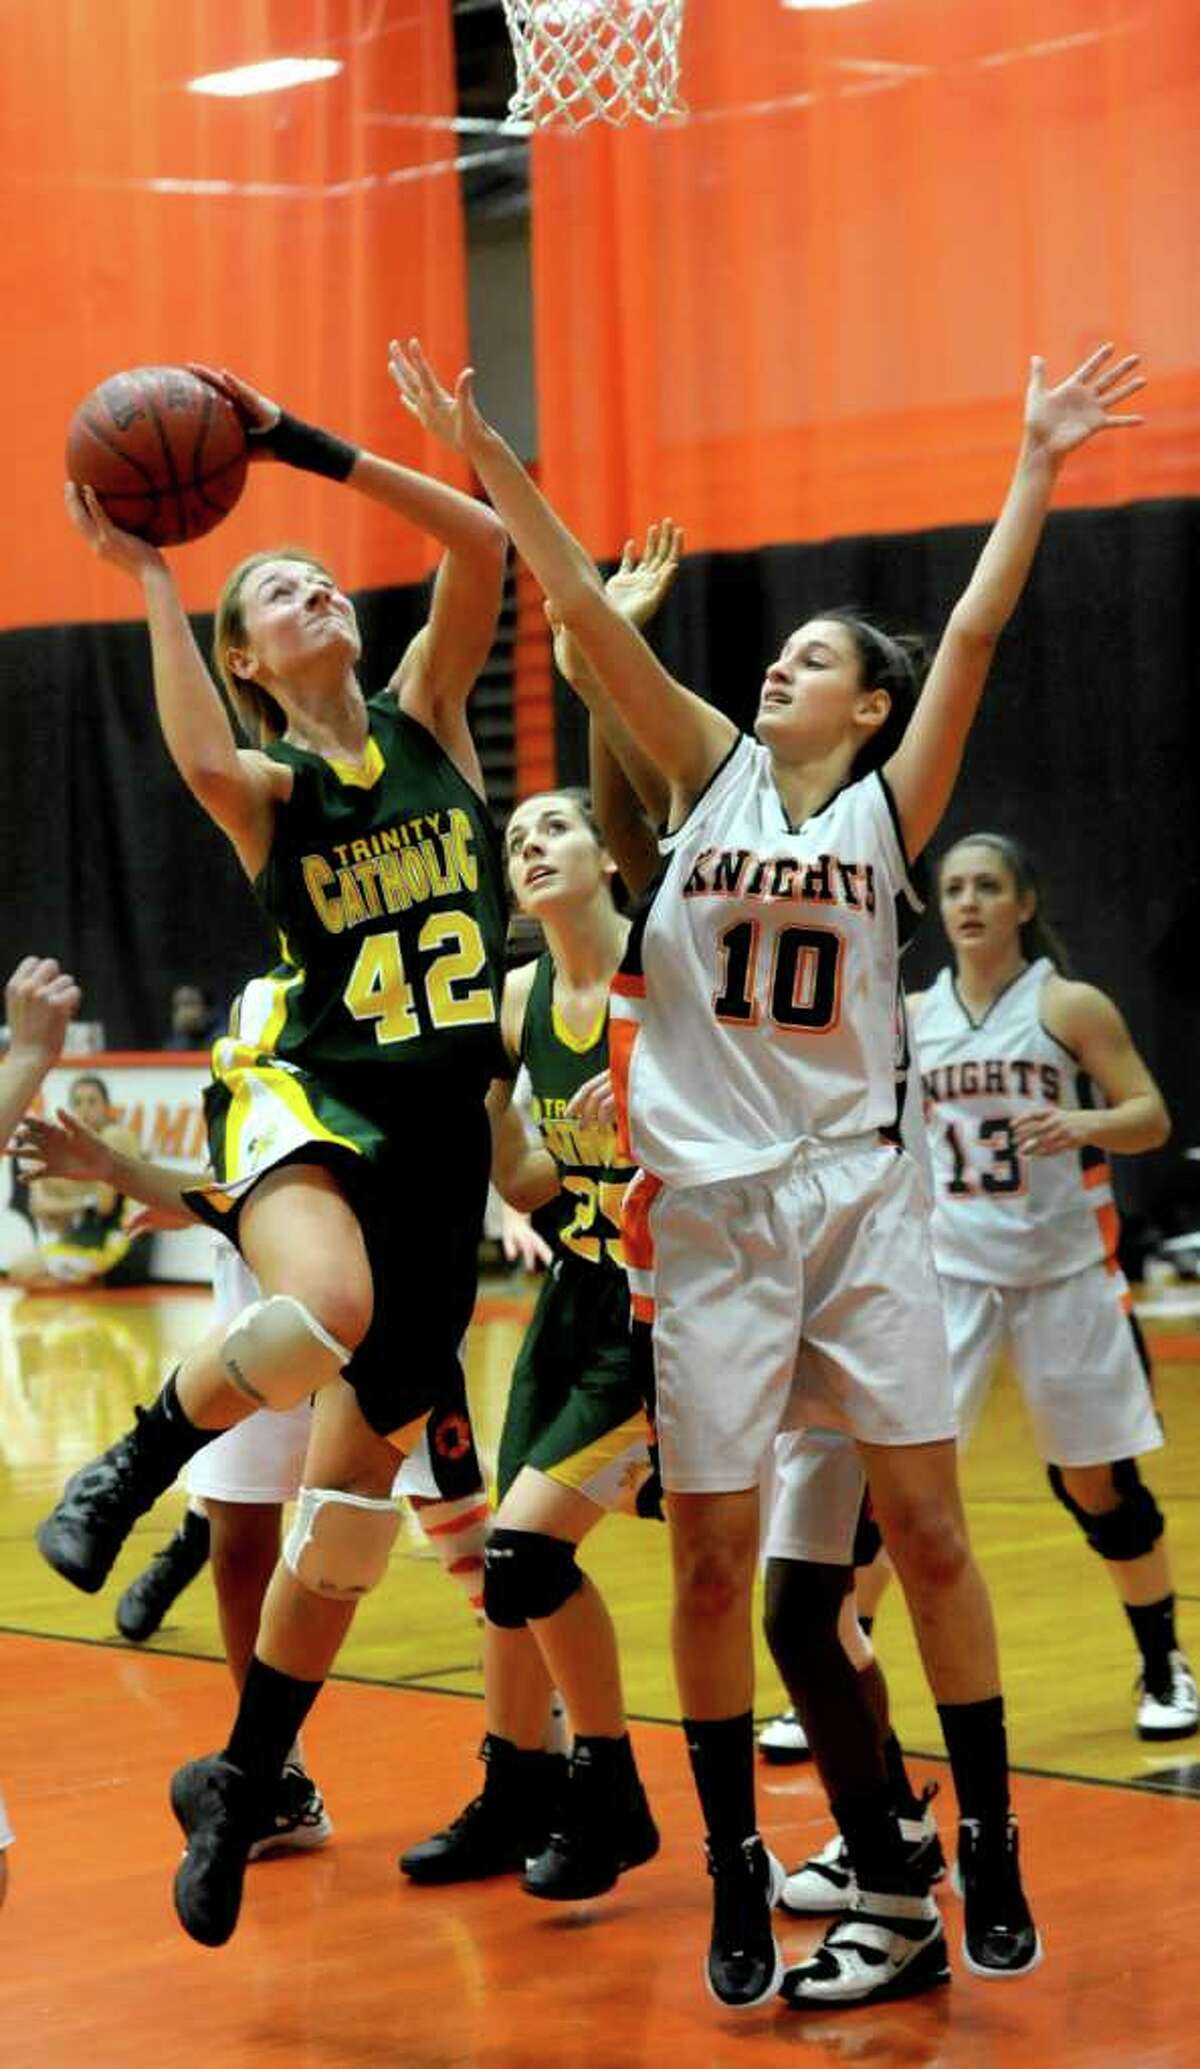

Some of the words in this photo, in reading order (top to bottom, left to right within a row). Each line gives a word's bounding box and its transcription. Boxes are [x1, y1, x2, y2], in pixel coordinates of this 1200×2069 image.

[300, 807, 478, 934] CATHOLIC
[332, 812, 440, 866] TRINITY
[342, 910, 496, 1045] 42
[712, 917, 847, 1035] 10
[920, 1058, 1061, 1106] NIGHTS
[944, 1117, 1029, 1200] 13
